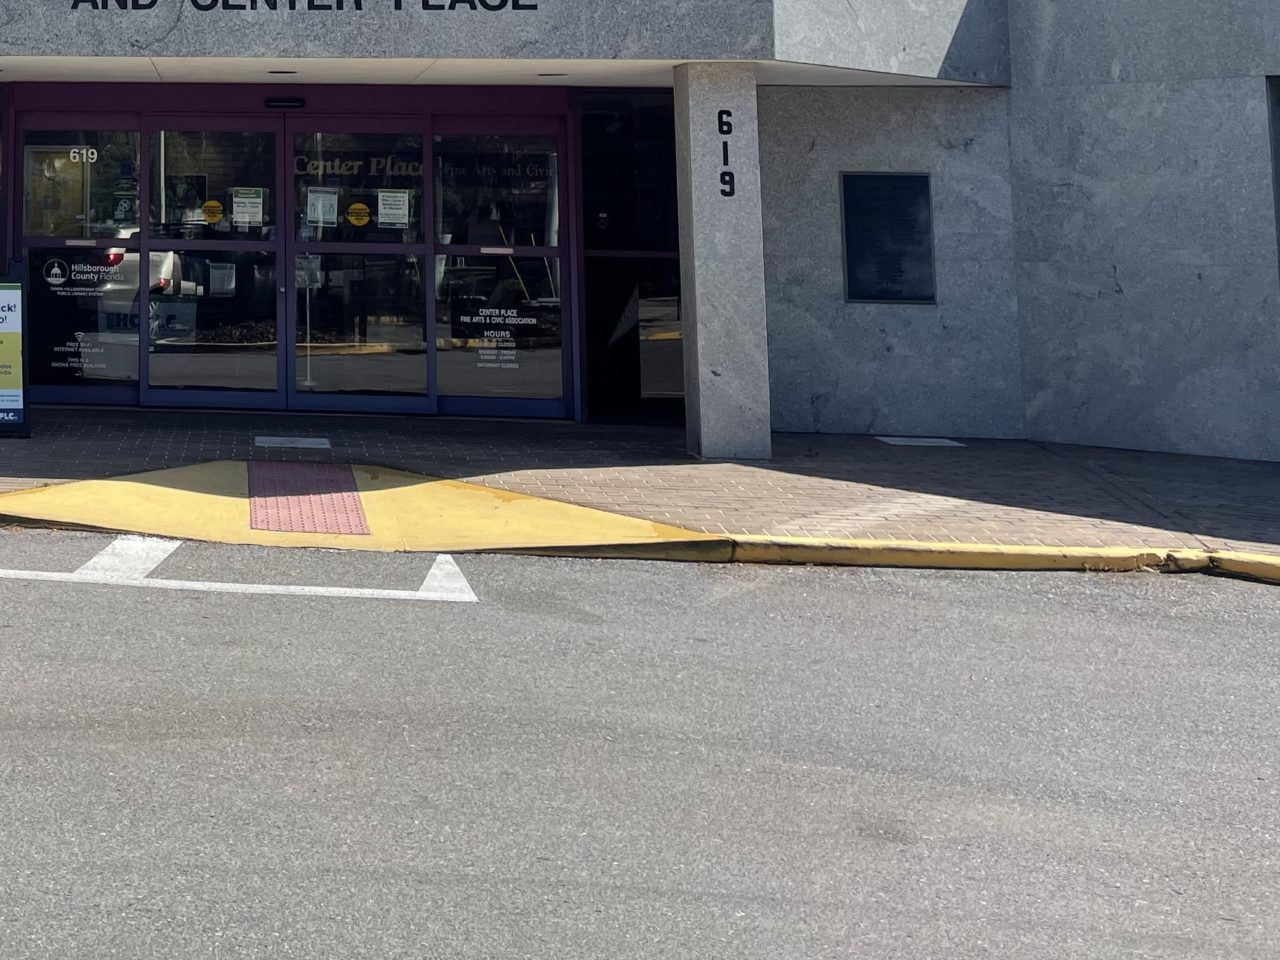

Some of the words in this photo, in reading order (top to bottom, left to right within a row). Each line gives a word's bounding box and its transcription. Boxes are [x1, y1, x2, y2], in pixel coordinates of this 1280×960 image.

[69, 148, 98, 163] 619
[718, 109, 735, 197] 619
[294, 155, 363, 176] Center
[72, 264, 119, 274] Hillsborough
[72, 272, 98, 281] County
[100, 273, 124, 281] Florida
